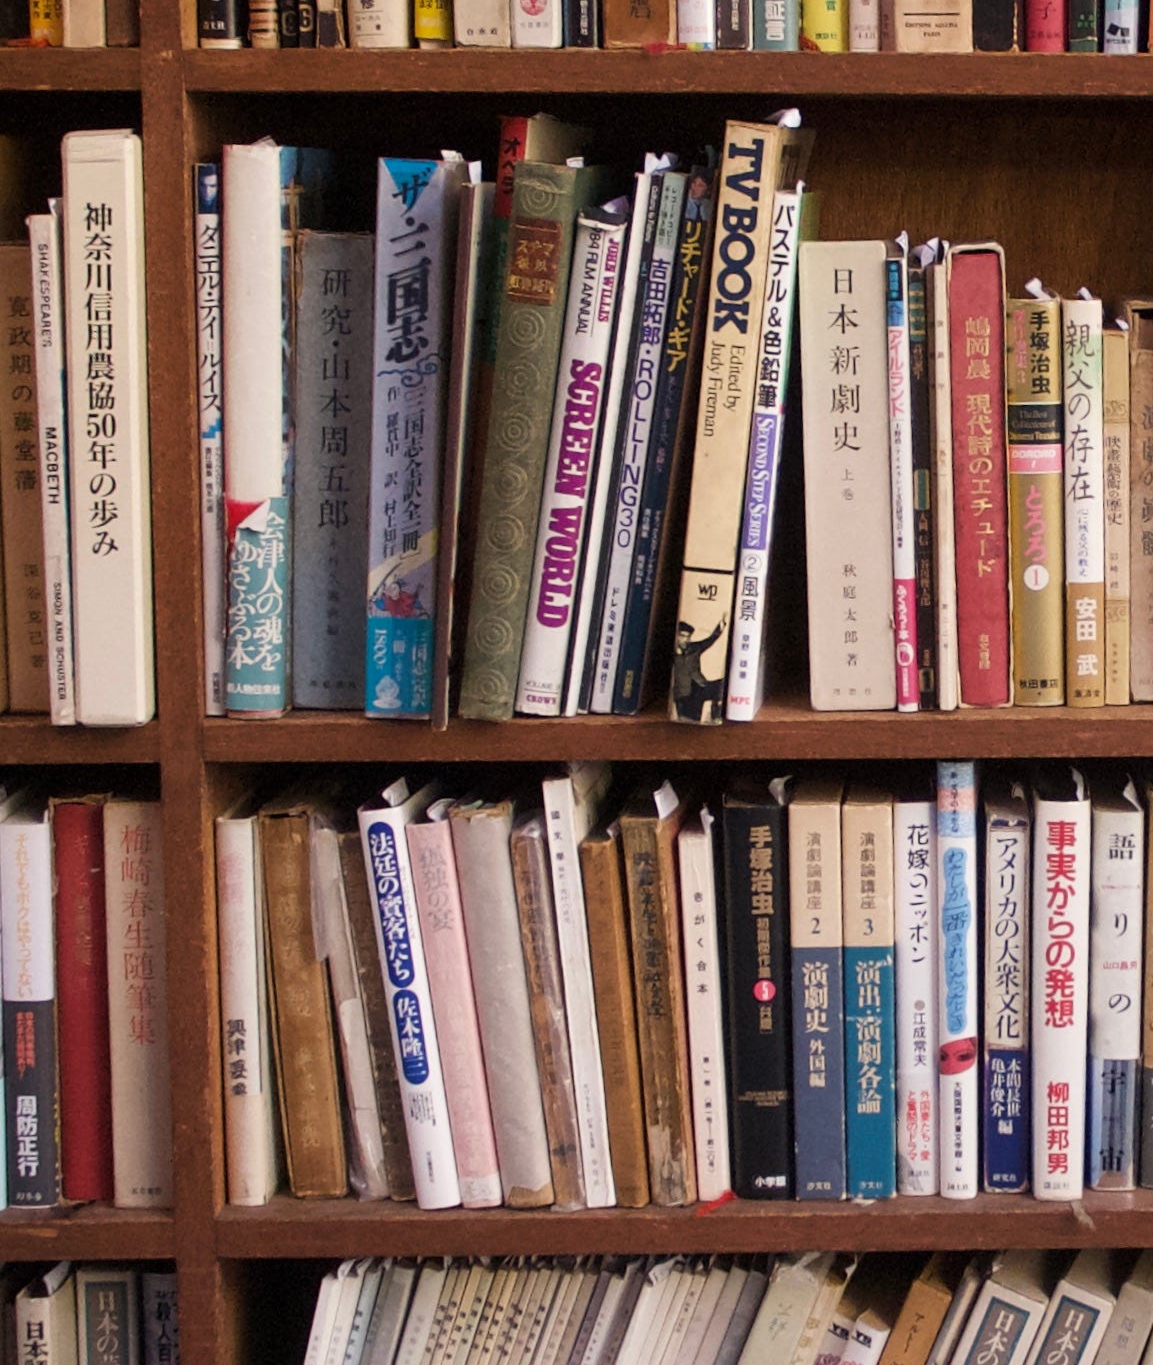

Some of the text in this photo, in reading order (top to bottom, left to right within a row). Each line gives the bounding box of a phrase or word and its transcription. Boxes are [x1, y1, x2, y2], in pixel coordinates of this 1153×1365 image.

[384, 173, 432, 362] ザ・三国志
[598, 237, 619, 322] JOHN WILLIS
[664, 219, 702, 373] リチャード・ギア
[711, 139, 765, 336] TV BOOK
[83, 202, 118, 556] 神奈川信用農協50年の歩み
[318, 268, 353, 530] 研究・山本周五郎
[701, 340, 725, 438] Judy Fireman
[725, 344, 746, 412] Edited by
[888, 329, 904, 418] アイルランド
[1029, 310, 1051, 396] 手塚治虫
[1065, 319, 1096, 503] 親父の存在
[44, 426, 59, 505] MACBETH
[52, 582, 62, 616] SIMON
[536, 359, 603, 628] SCREEN WORLD
[828, 268, 862, 667] 日本新劇史 秋庭太郎著
[966, 394, 995, 578] 現代詩のエチュード
[228, 538, 254, 670] ゆさぶる本
[254, 513, 284, 670] 会津人の魂を
[1019, 679, 1059, 690] 秋田書店
[120, 824, 155, 1046] 梅崎春生随筆集
[748, 825, 775, 916] 手塚治虫
[801, 832, 830, 1033] 演劇論講座 2 演劇史
[860, 832, 876, 936] 演劇論講座 3
[906, 824, 929, 1067] 花嫁のニッポン 江成常夫
[994, 838, 1019, 1040] アメリカの大衆文化
[15, 834, 38, 1178] それでもボクはやってない 周防正行
[1045, 820, 1078, 1175] 事実からの発想 柳田邦男
